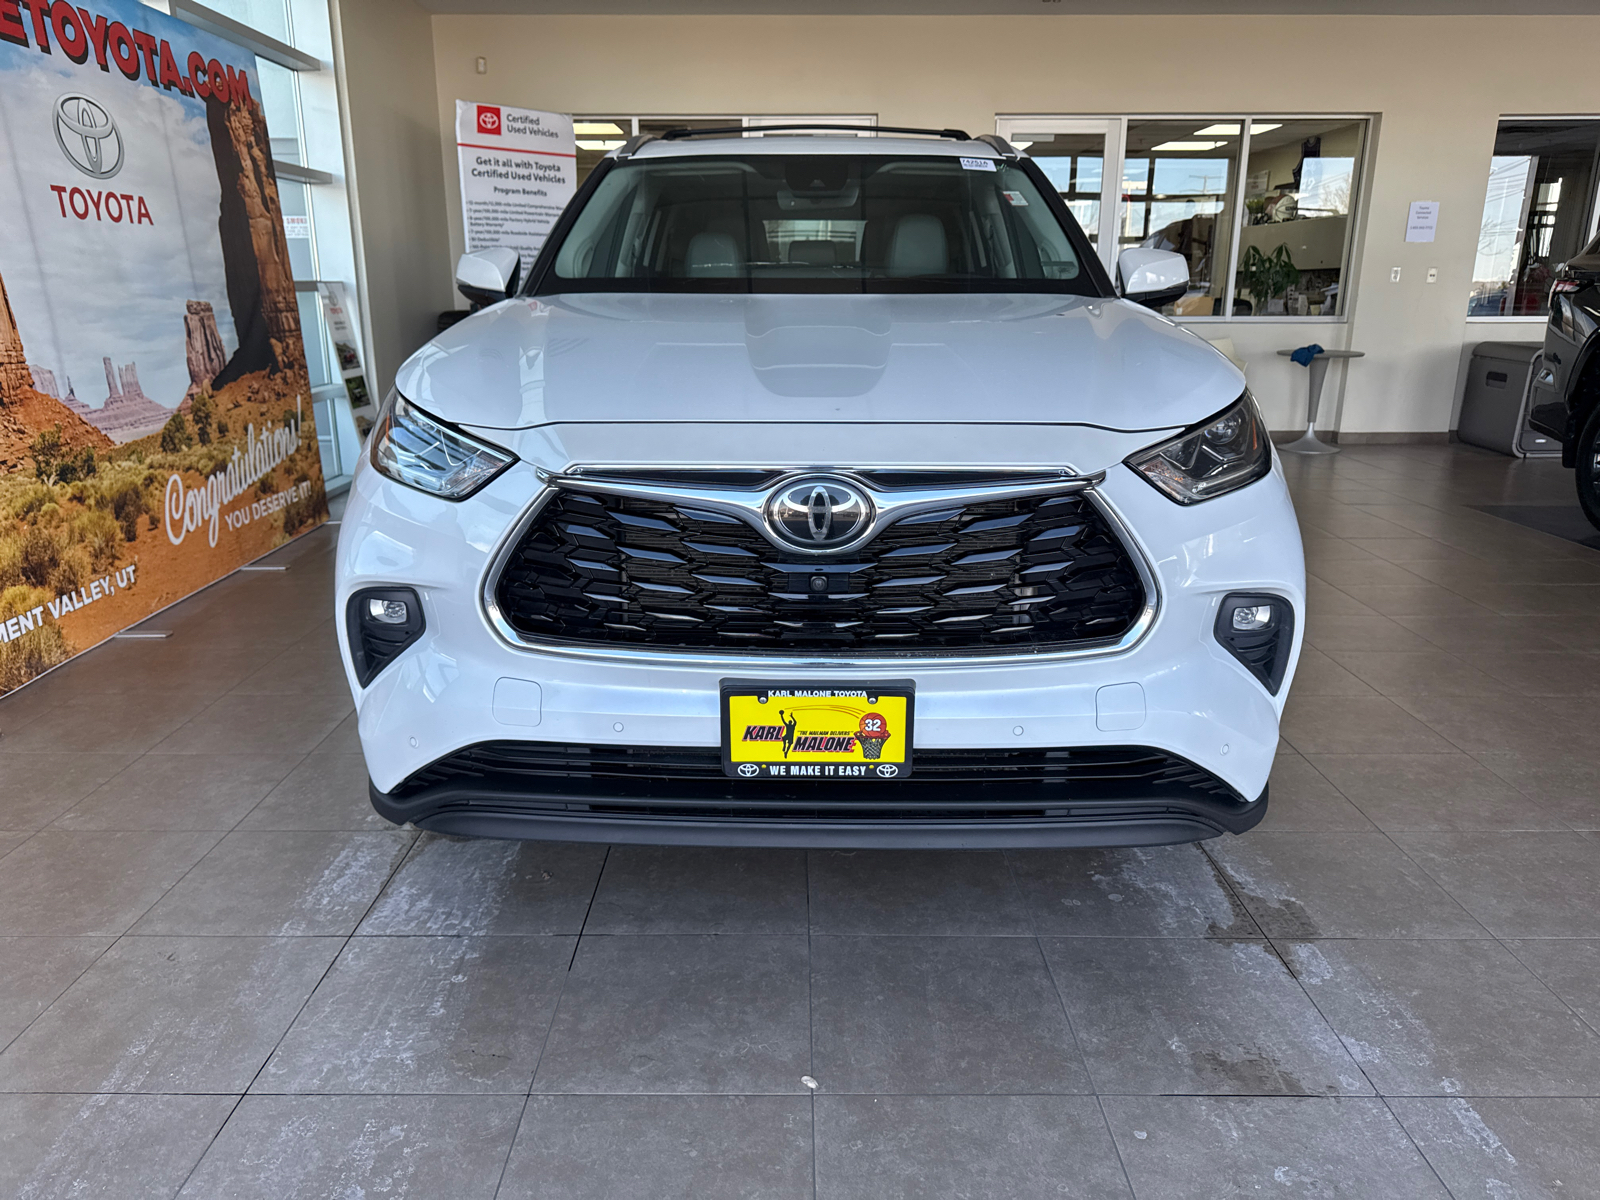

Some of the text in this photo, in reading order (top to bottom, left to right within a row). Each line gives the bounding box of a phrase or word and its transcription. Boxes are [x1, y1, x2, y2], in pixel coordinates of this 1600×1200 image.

[507, 114, 540, 126] Certified
[507, 125, 559, 138] Used Vehicles
[476, 156, 561, 173] Get it all with Toyota
[472, 168, 566, 184] Certified Used Vehicles
[494, 186, 548, 196] Program Benefits
[50, 184, 154, 226] TOYOTA
[165, 394, 302, 548] Congratulations!
[225, 480, 312, 532] YOU DESERVE IT!
[47, 576, 114, 619] VALLEY,
[116, 565, 136, 588] UT
[742, 725, 786, 742] KARL
[864, 719, 882, 732] 32
[792, 736, 856, 753] MALONE
[770, 765, 866, 776] WE MAKE IT EASY
